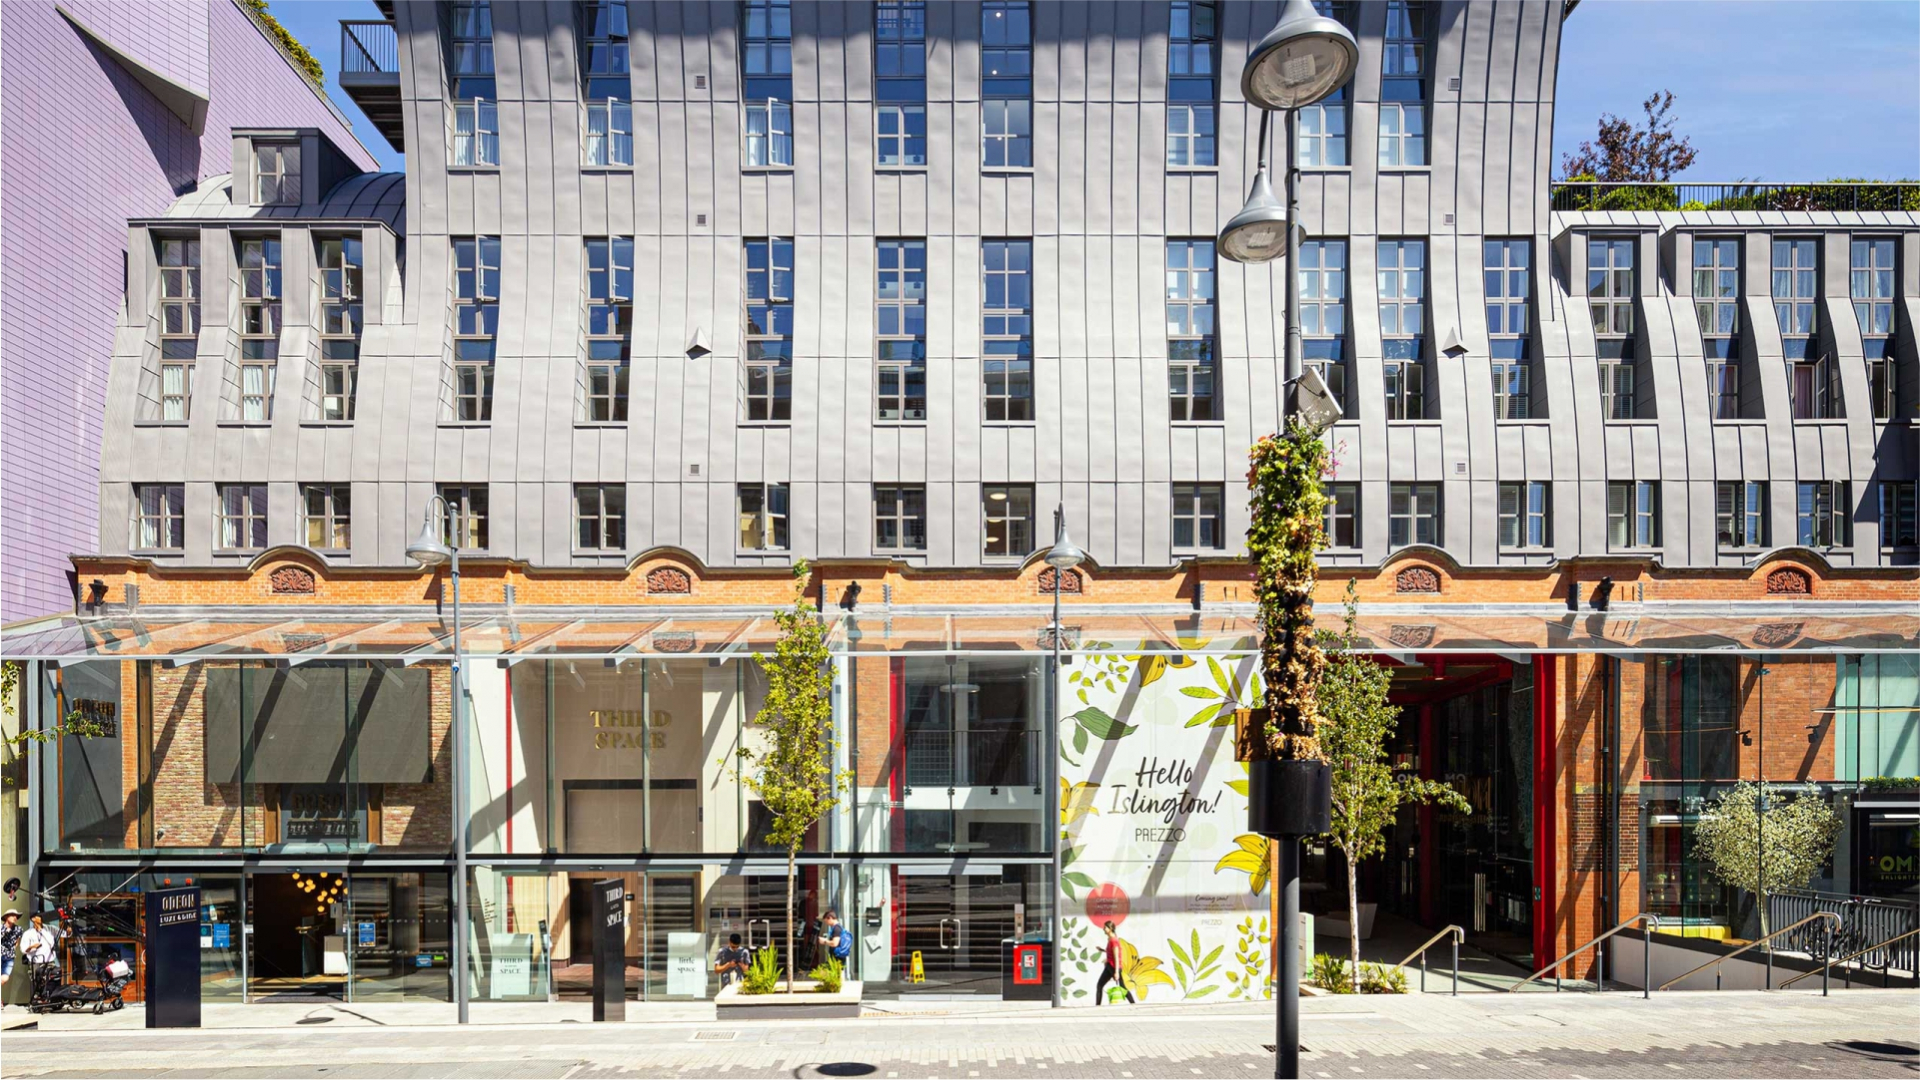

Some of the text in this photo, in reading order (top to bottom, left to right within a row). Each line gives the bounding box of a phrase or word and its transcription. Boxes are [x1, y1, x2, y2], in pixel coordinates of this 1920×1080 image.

[1135, 756, 1193, 788] Hello
[1107, 784, 1223, 824] Islington!
[1135, 827, 1187, 842] PREZZO
[162, 893, 195, 911] ODEON
[606, 886, 624, 903] THIRD
[678, 956, 695, 965] little
[677, 966, 696, 974] space
